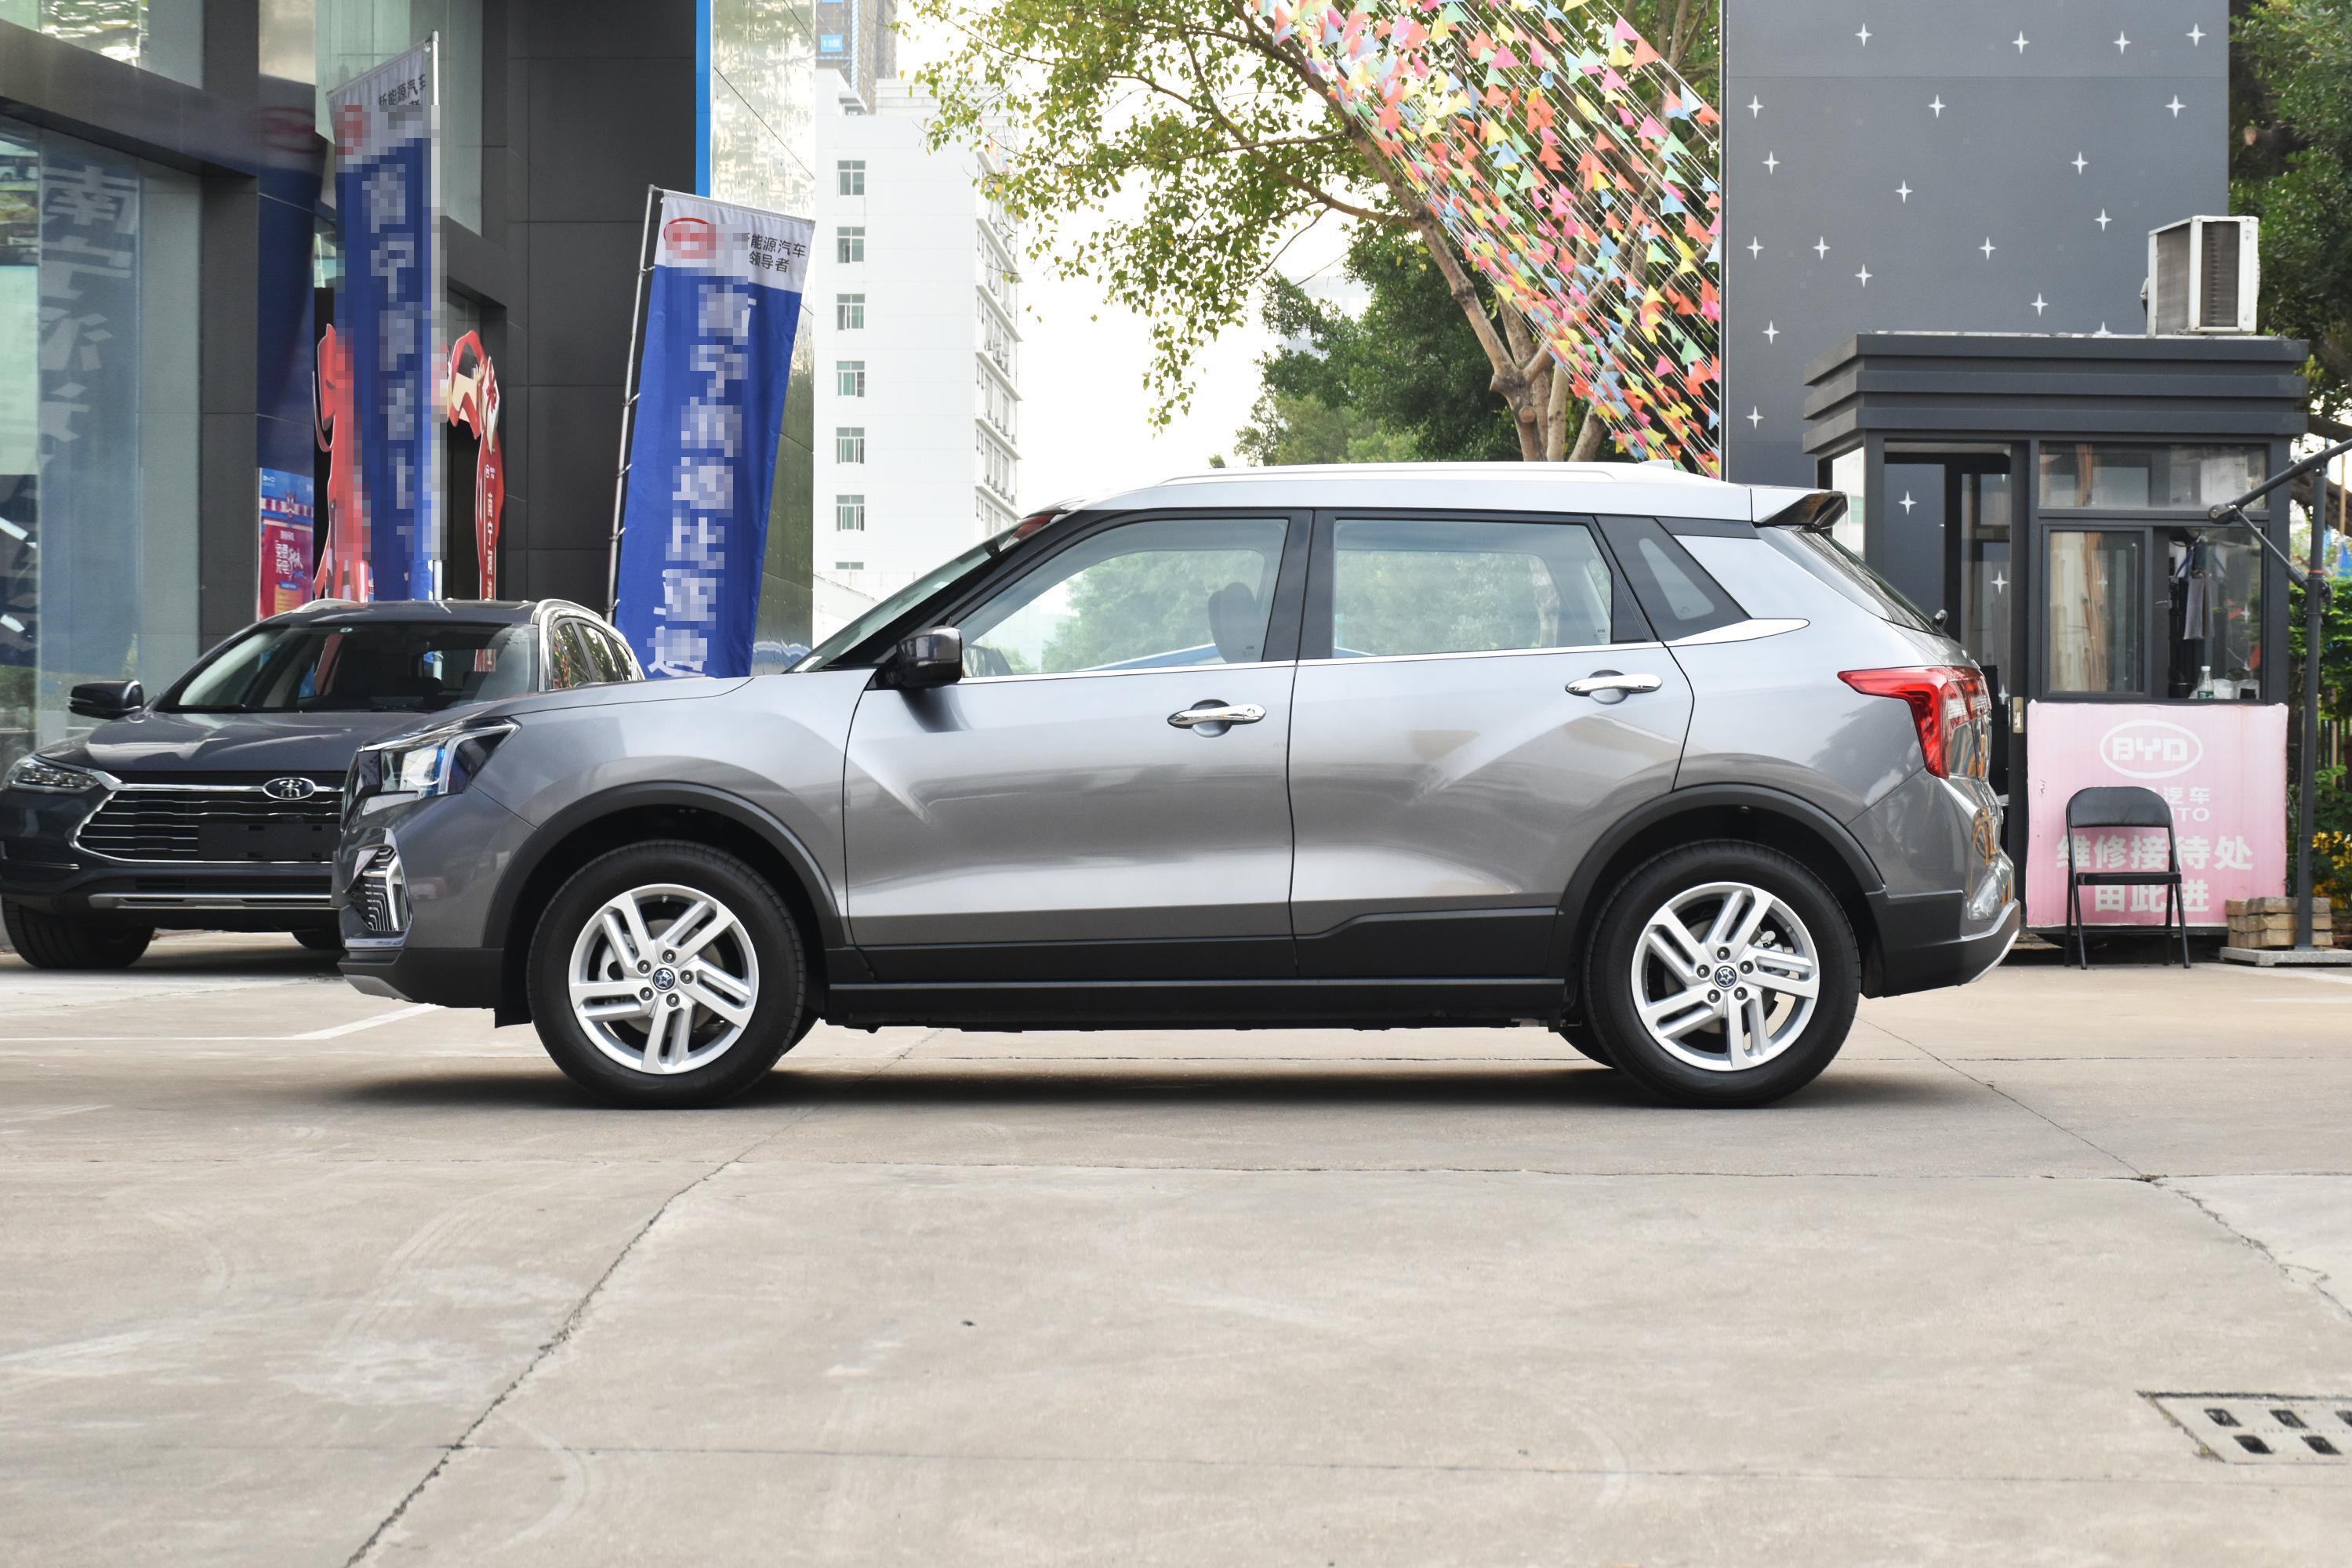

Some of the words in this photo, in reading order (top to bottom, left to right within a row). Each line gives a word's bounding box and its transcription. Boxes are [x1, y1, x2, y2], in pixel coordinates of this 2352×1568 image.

[748, 232, 806, 258] 能源汽车
[750, 251, 789, 273] 领导者
[2113, 737, 2188, 760] BYD
[2147, 786, 2210, 804] 汽车
[2057, 833, 2253, 870] 维修接待处
